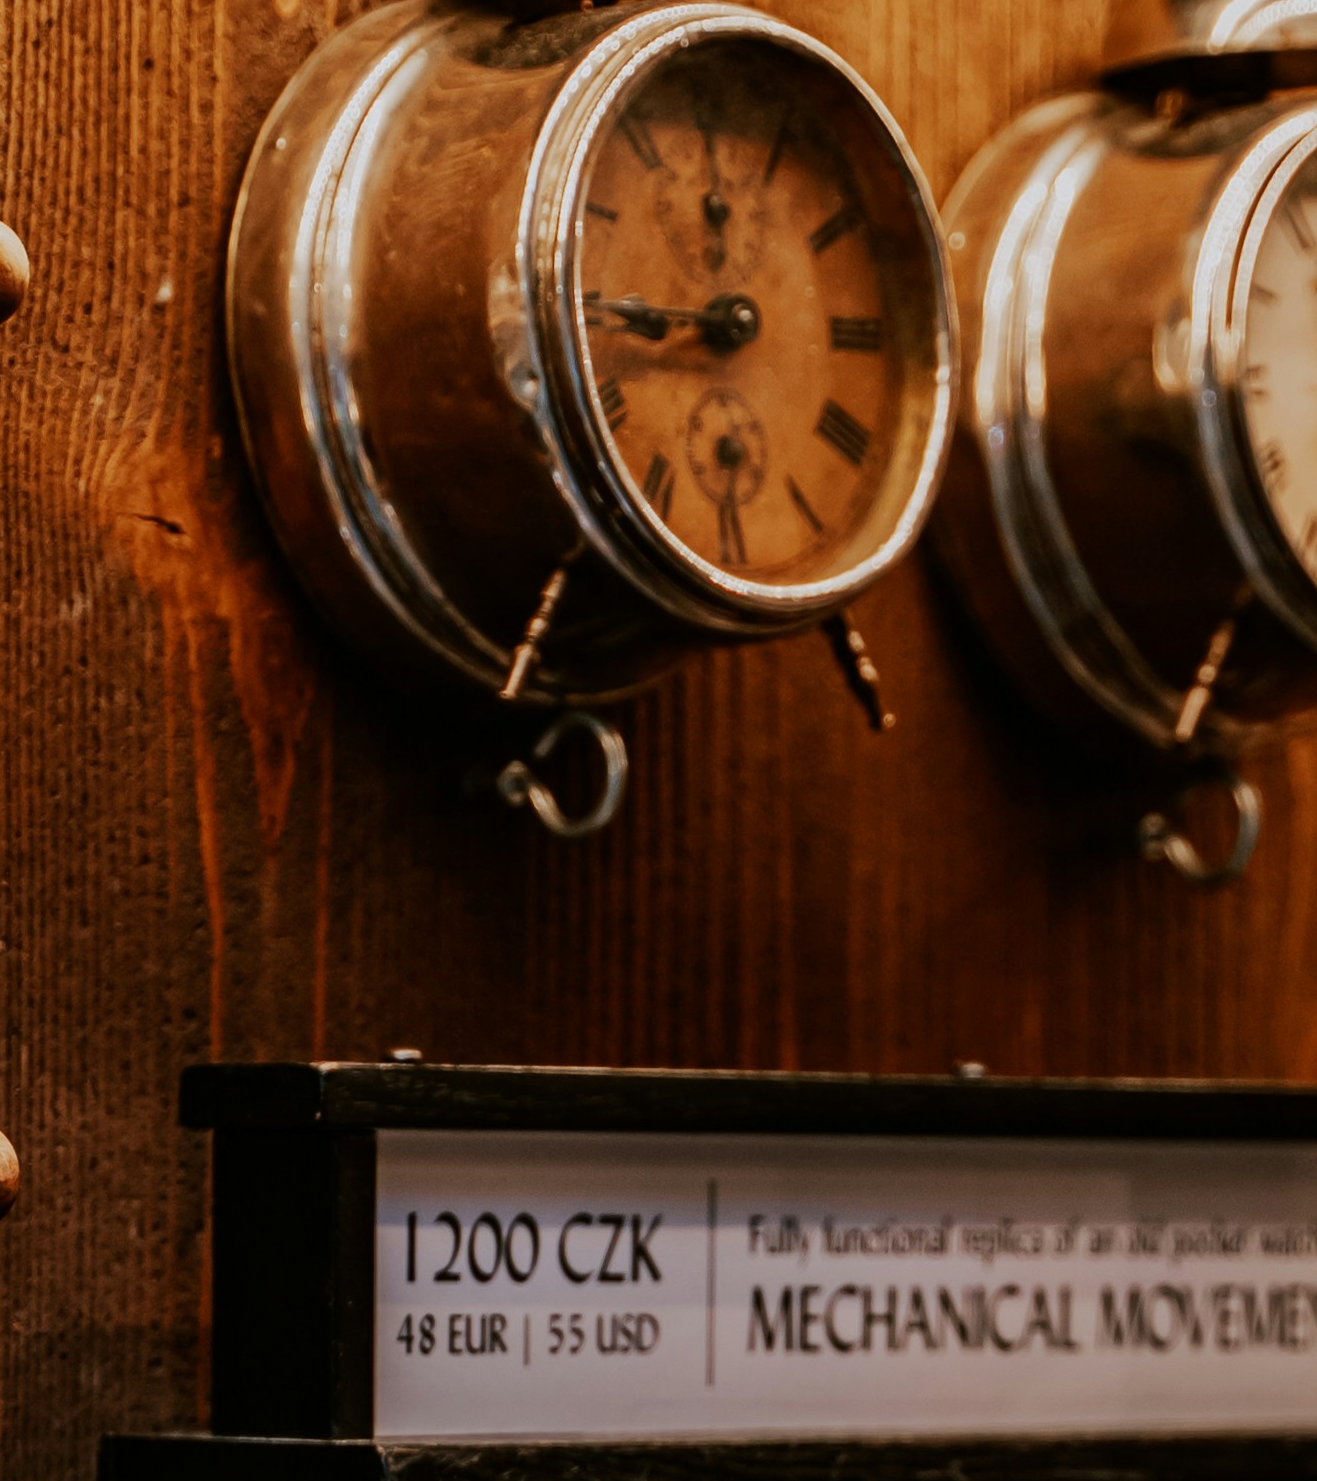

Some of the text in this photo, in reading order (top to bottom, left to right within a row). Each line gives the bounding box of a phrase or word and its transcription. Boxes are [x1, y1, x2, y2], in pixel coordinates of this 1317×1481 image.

[406, 1210, 662, 1285] 1200 CZK
[748, 1213, 809, 1267] Fully
[396, 1312, 661, 1356] 48 EUR 55 USD
[747, 1283, 1079, 1354] MECHANICAL
